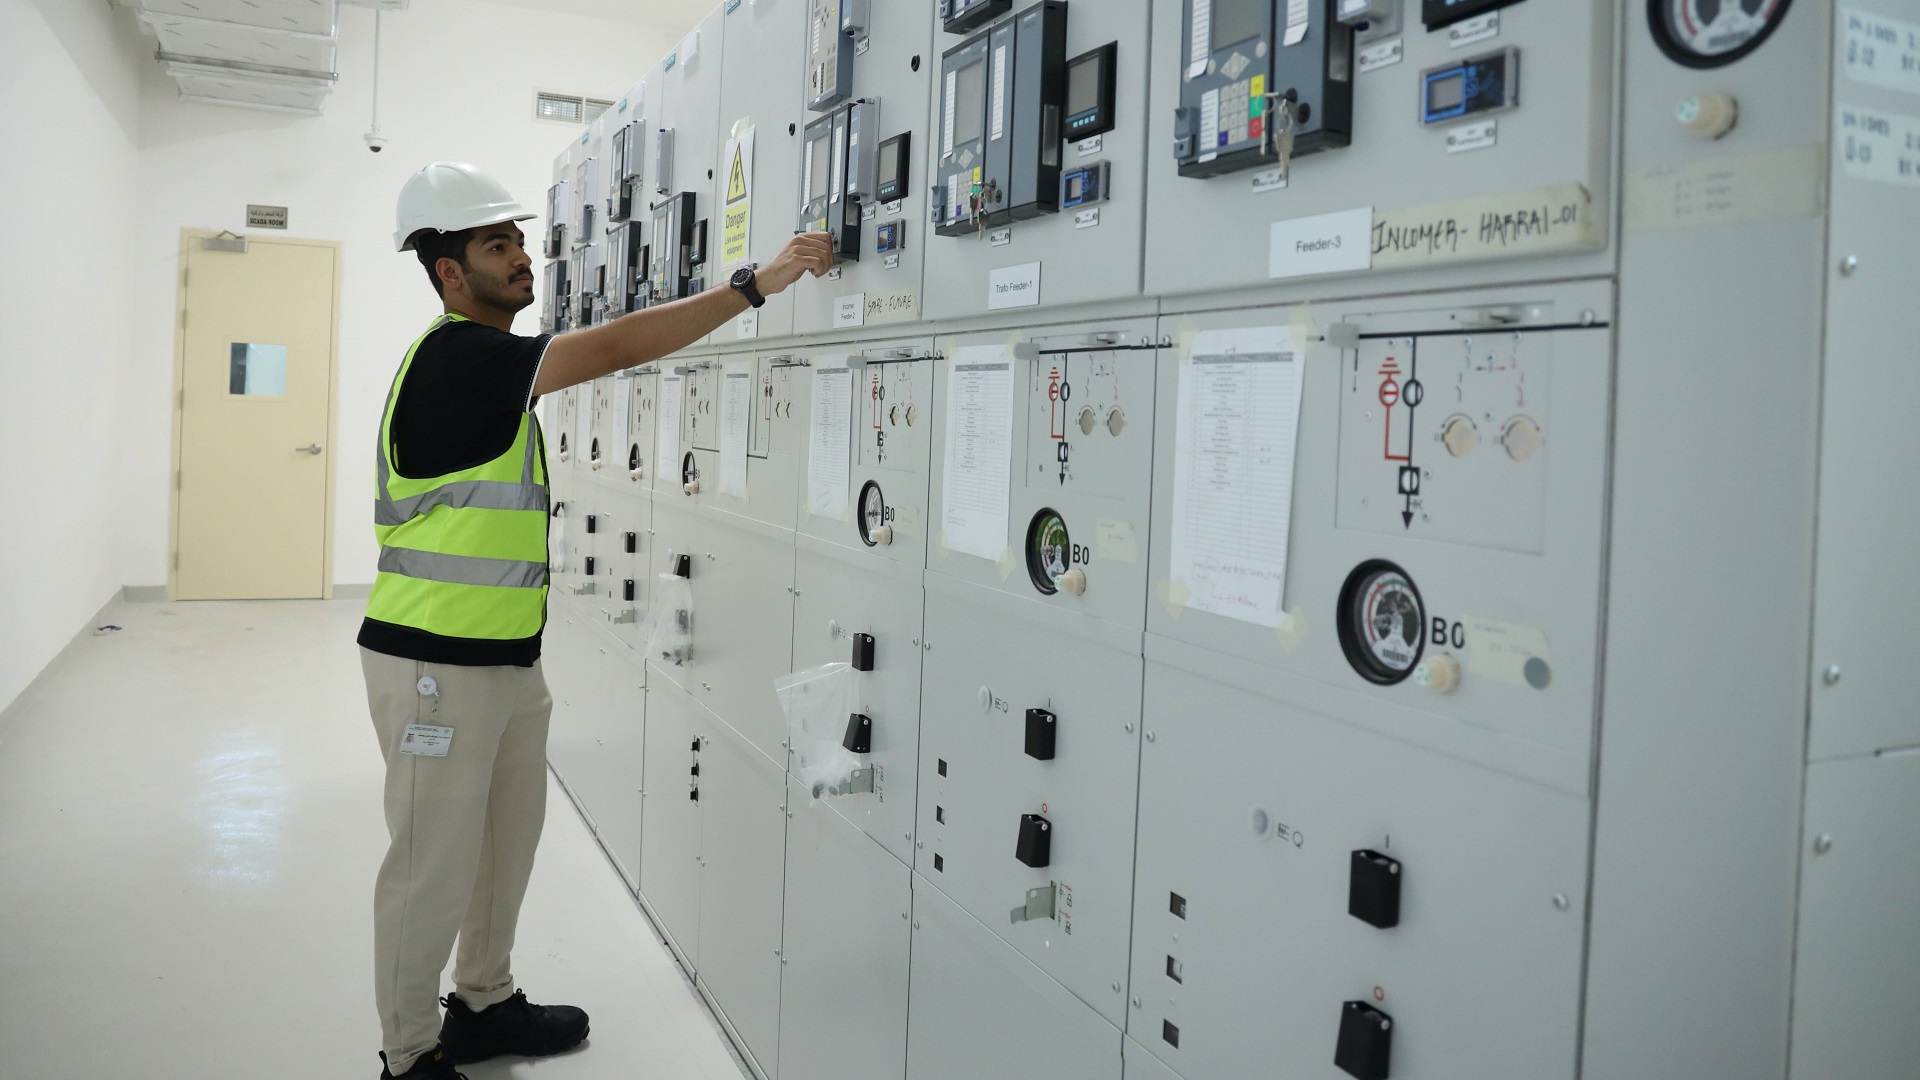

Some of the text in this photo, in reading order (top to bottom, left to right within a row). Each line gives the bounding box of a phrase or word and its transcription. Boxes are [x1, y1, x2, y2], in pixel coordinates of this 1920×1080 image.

[725, 211, 747, 229] Danger
[732, 230, 746, 242] electrical
[726, 243, 743, 255] equipment
[1296, 235, 1342, 252] Feeder-3
[996, 280, 1033, 293] Trafo Feeder-1
